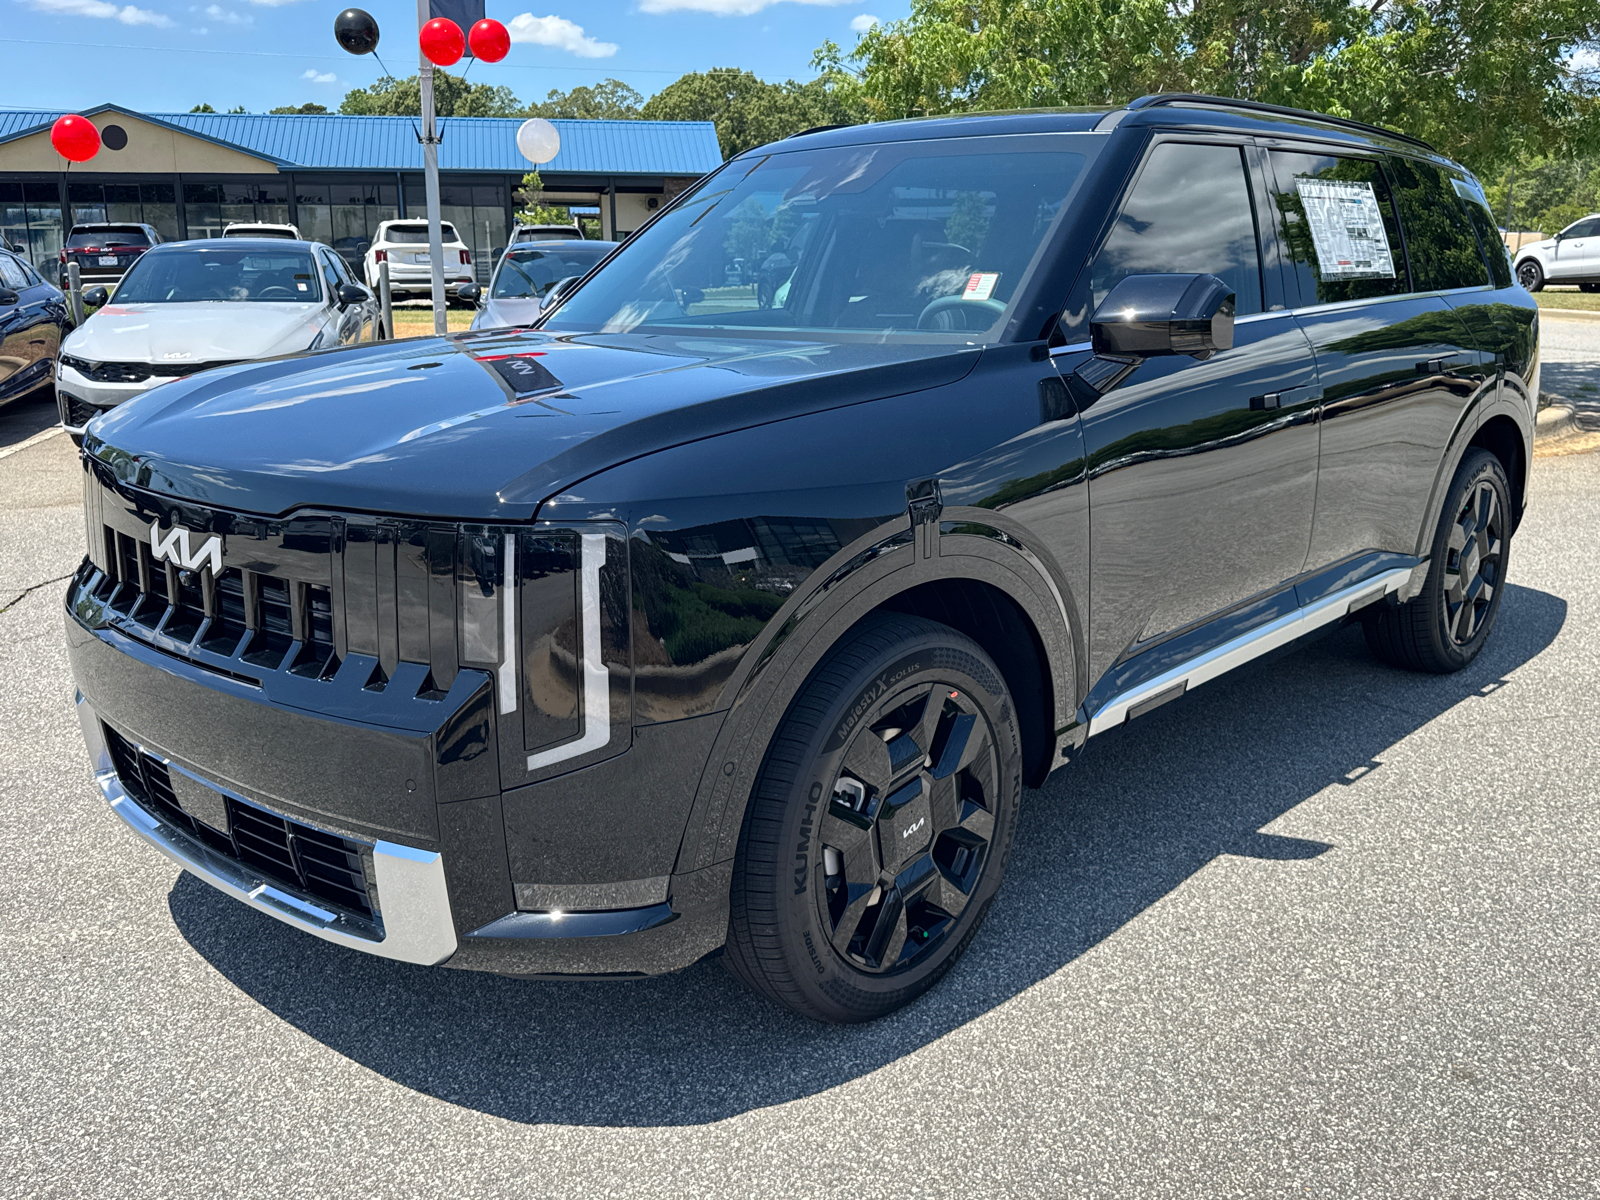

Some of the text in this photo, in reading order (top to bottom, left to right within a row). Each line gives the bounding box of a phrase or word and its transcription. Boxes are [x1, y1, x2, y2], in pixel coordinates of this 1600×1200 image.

[149, 519, 224, 577] KIA
[794, 781, 823, 895] KUMHO
[903, 817, 924, 838] KIA
[1001, 773, 1021, 869] KUMHO
[803, 930, 825, 975] OUTSIDE
